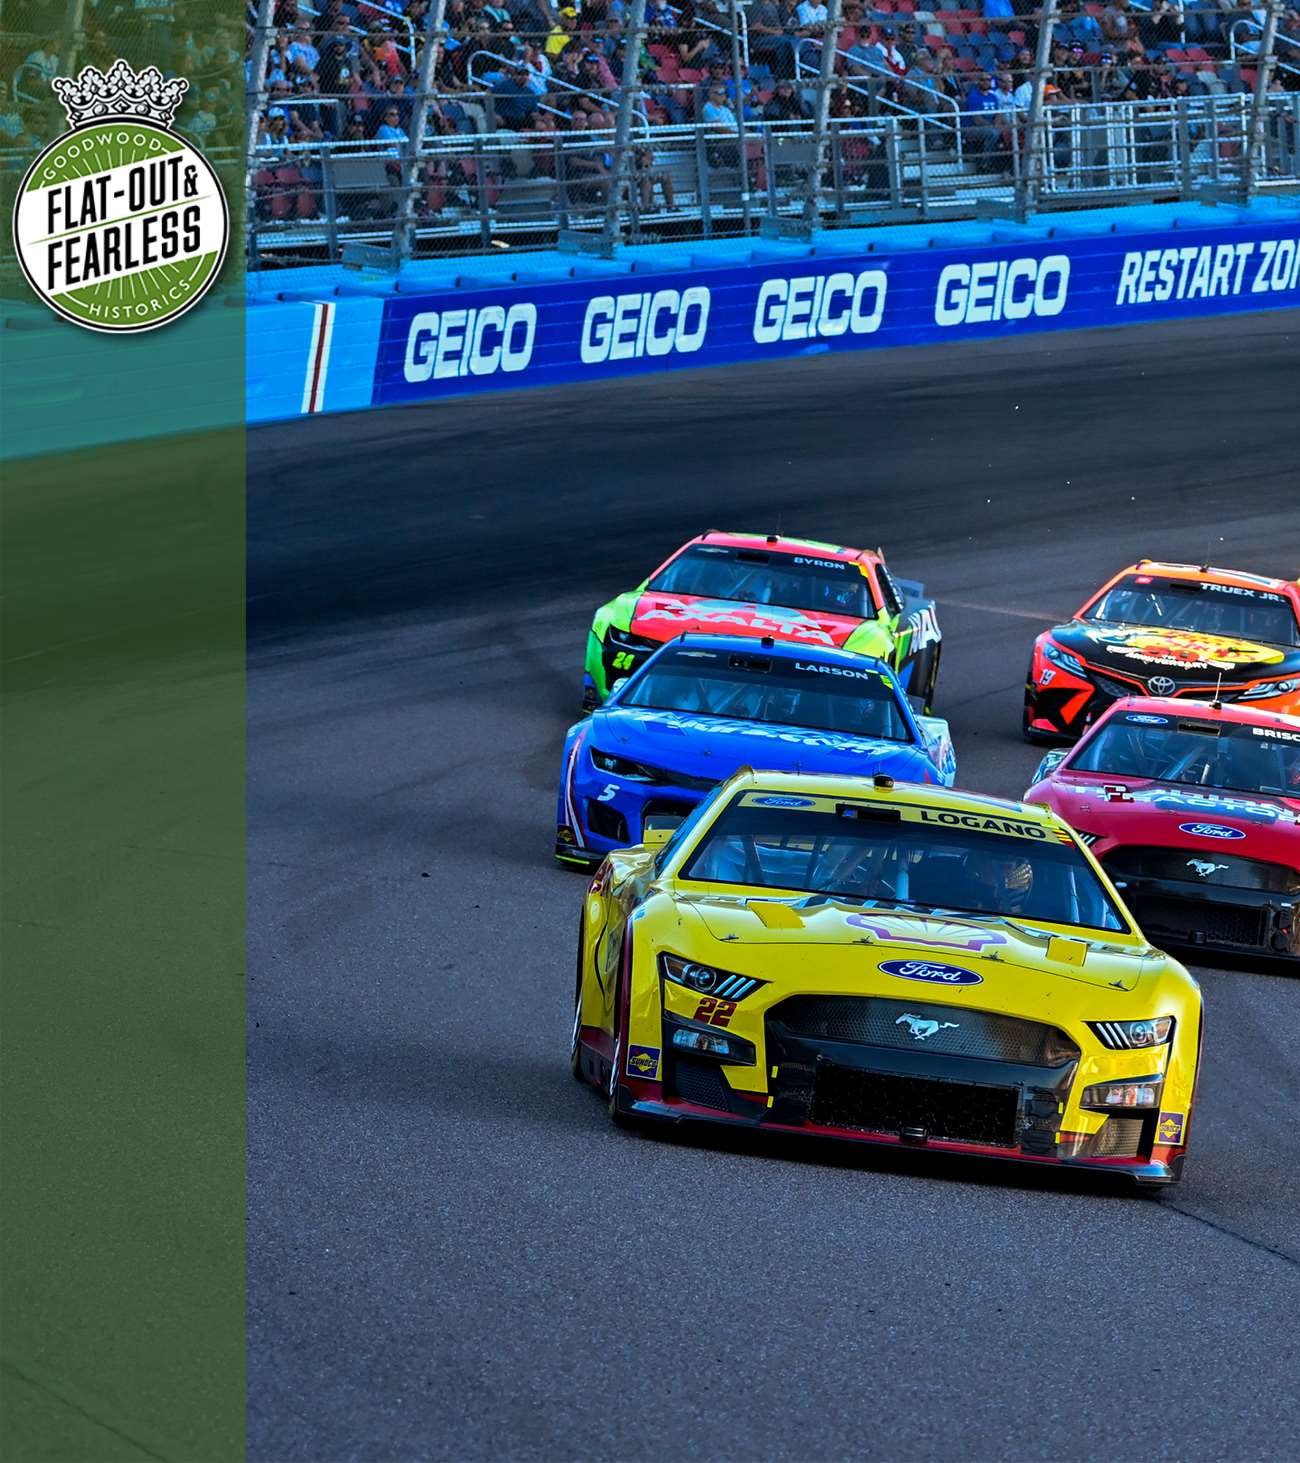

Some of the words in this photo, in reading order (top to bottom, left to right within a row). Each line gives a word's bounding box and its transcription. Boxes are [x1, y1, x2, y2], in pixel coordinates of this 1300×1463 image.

[1116, 242, 1254, 305] RESTART
[935, 254, 1070, 326] GEICO
[753, 270, 888, 343] GEICO
[581, 286, 710, 364] GEICO
[404, 303, 537, 383] GEICO
[793, 556, 846, 571] BYRON
[1200, 582, 1255, 598] TRUEX
[1258, 591, 1286, 603] JR.
[636, 609, 836, 647] AXALTA
[612, 651, 635, 670] 24
[794, 661, 869, 681] LARSON
[1040, 669, 1057, 686] 19
[597, 783, 620, 802] 5
[919, 809, 1047, 840] LOGANO
[1190, 823, 1234, 839] Ford
[898, 960, 963, 983] Ford
[692, 996, 738, 1028] 22
